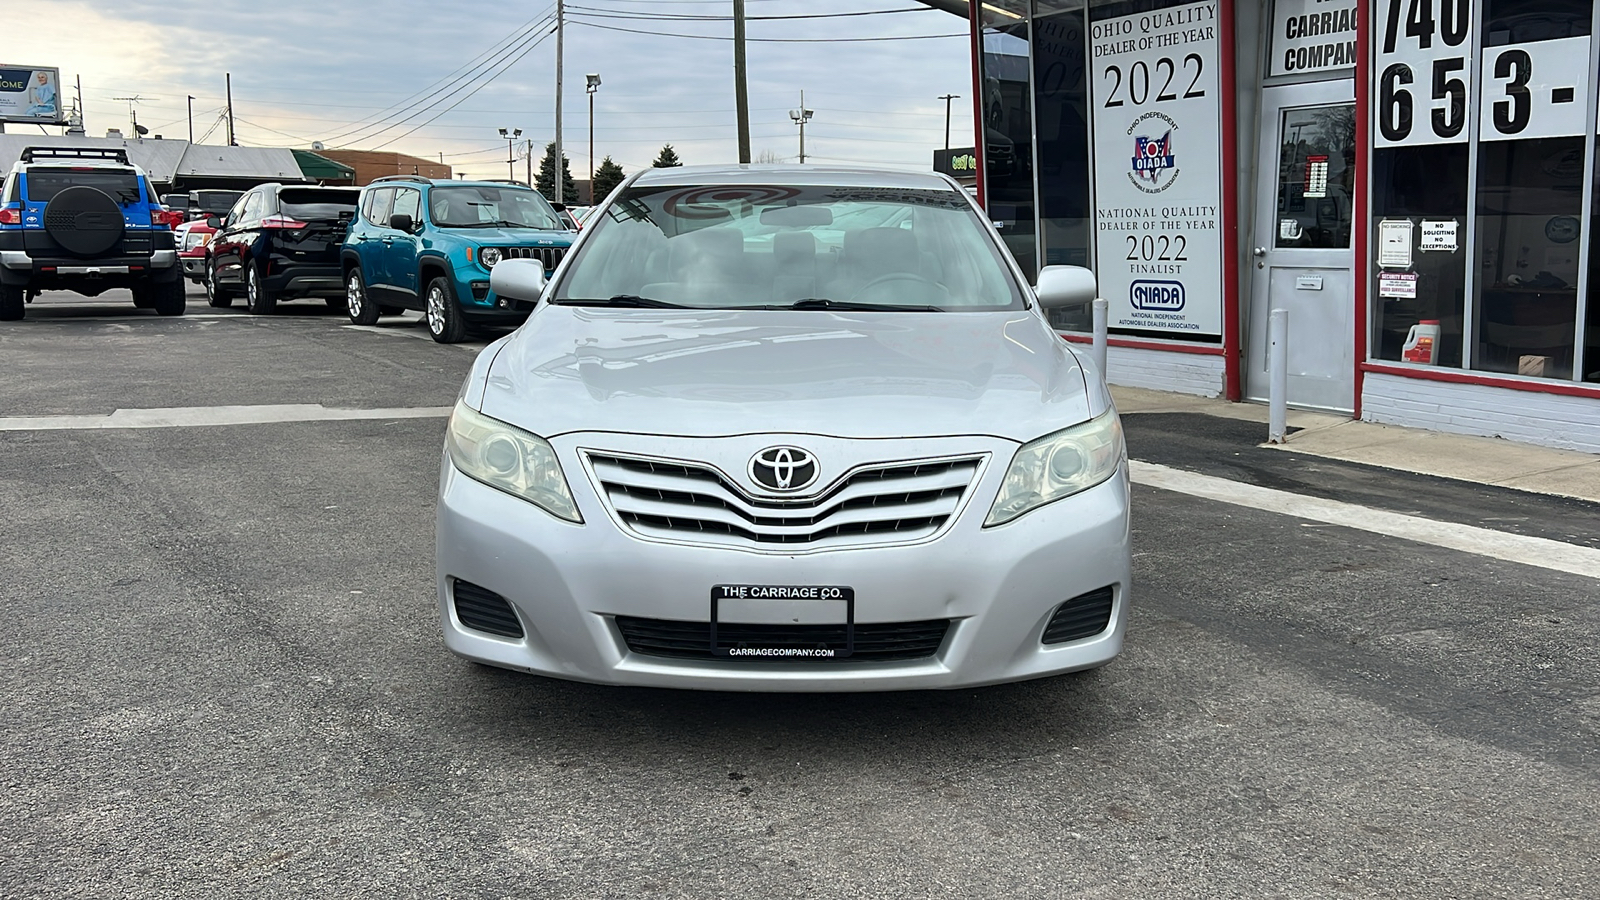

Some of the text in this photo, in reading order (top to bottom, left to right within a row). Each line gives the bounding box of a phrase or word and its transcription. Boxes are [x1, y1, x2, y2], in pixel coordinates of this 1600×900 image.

[1092, 4, 1216, 39] OHIO QUALITY
[1094, 27, 1214, 57] DEALER OF THE YEAR
[1104, 53, 1205, 108] 2022
[1127, 111, 1179, 135] OHIO INDEPENDENT
[1137, 157, 1167, 169] OIADA
[1098, 206, 1216, 218] NATIONAL QUALITY
[1100, 220, 1215, 230] DEALER OF THE YEAR
[1126, 235, 1187, 261] 2022
[1130, 264, 1182, 274] FINALIST
[1134, 286, 1180, 305] NIADA
[1167, 322, 1199, 330] ASSOCIATION
[722, 586, 843, 598] THE CARRIAGE CO.
[729, 648, 835, 657] CARRIAGECOMPANY.COM
